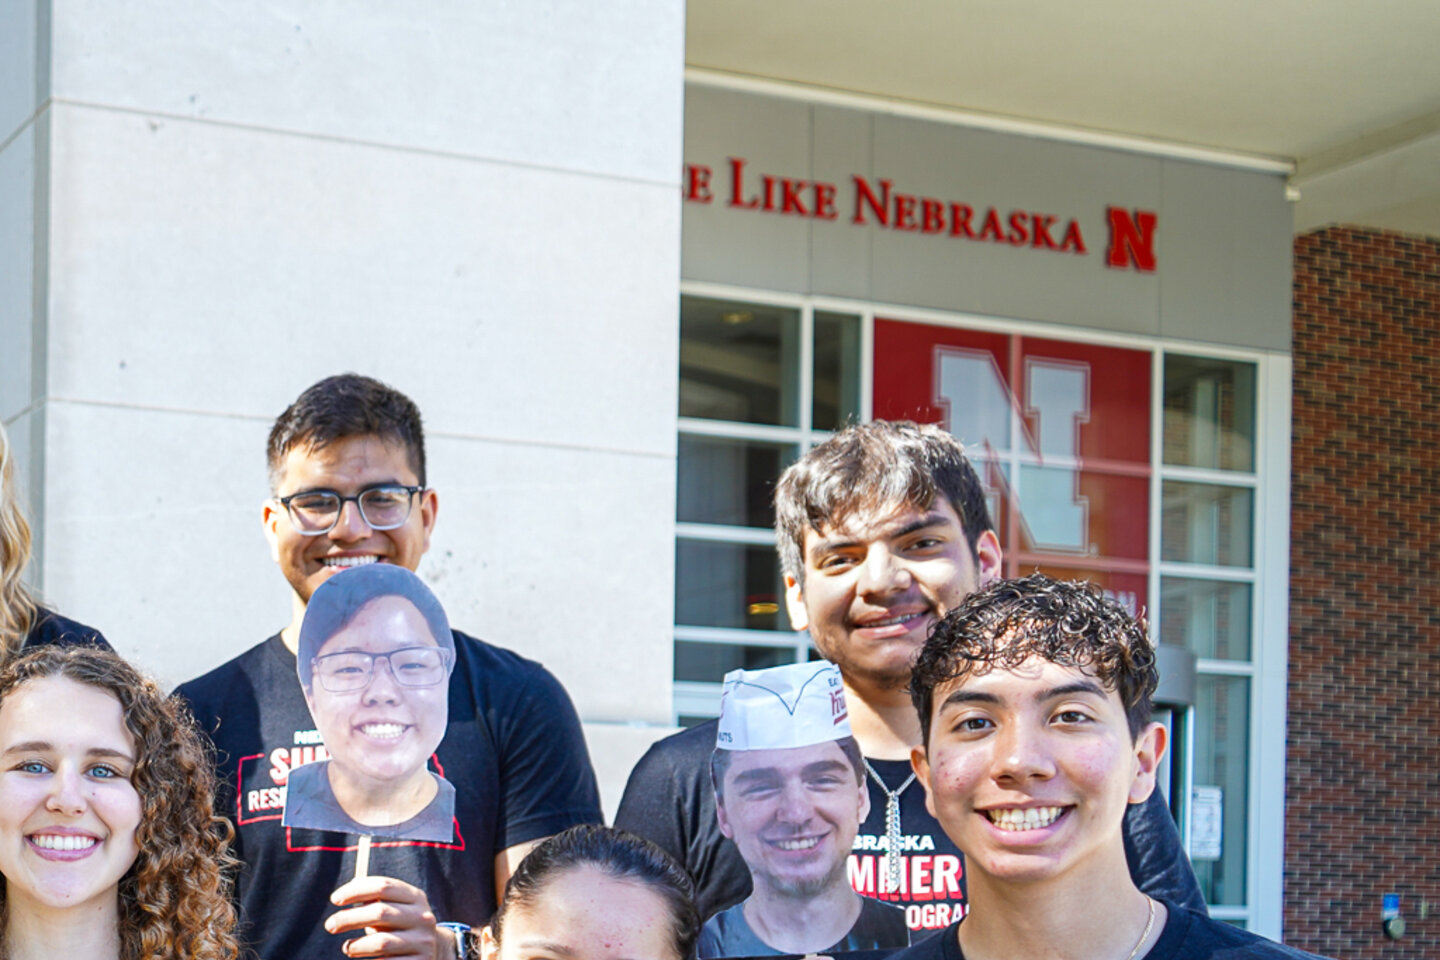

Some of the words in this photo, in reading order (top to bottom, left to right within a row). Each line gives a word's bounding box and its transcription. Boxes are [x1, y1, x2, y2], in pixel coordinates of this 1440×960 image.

[682, 162, 714, 205] E
[727, 155, 839, 221] LIKE
[850, 173, 1088, 256] NEBRASKA
[1105, 204, 1158, 276] N
[852, 834, 935, 850] BRAKA
[905, 903, 970, 931] OGRA
